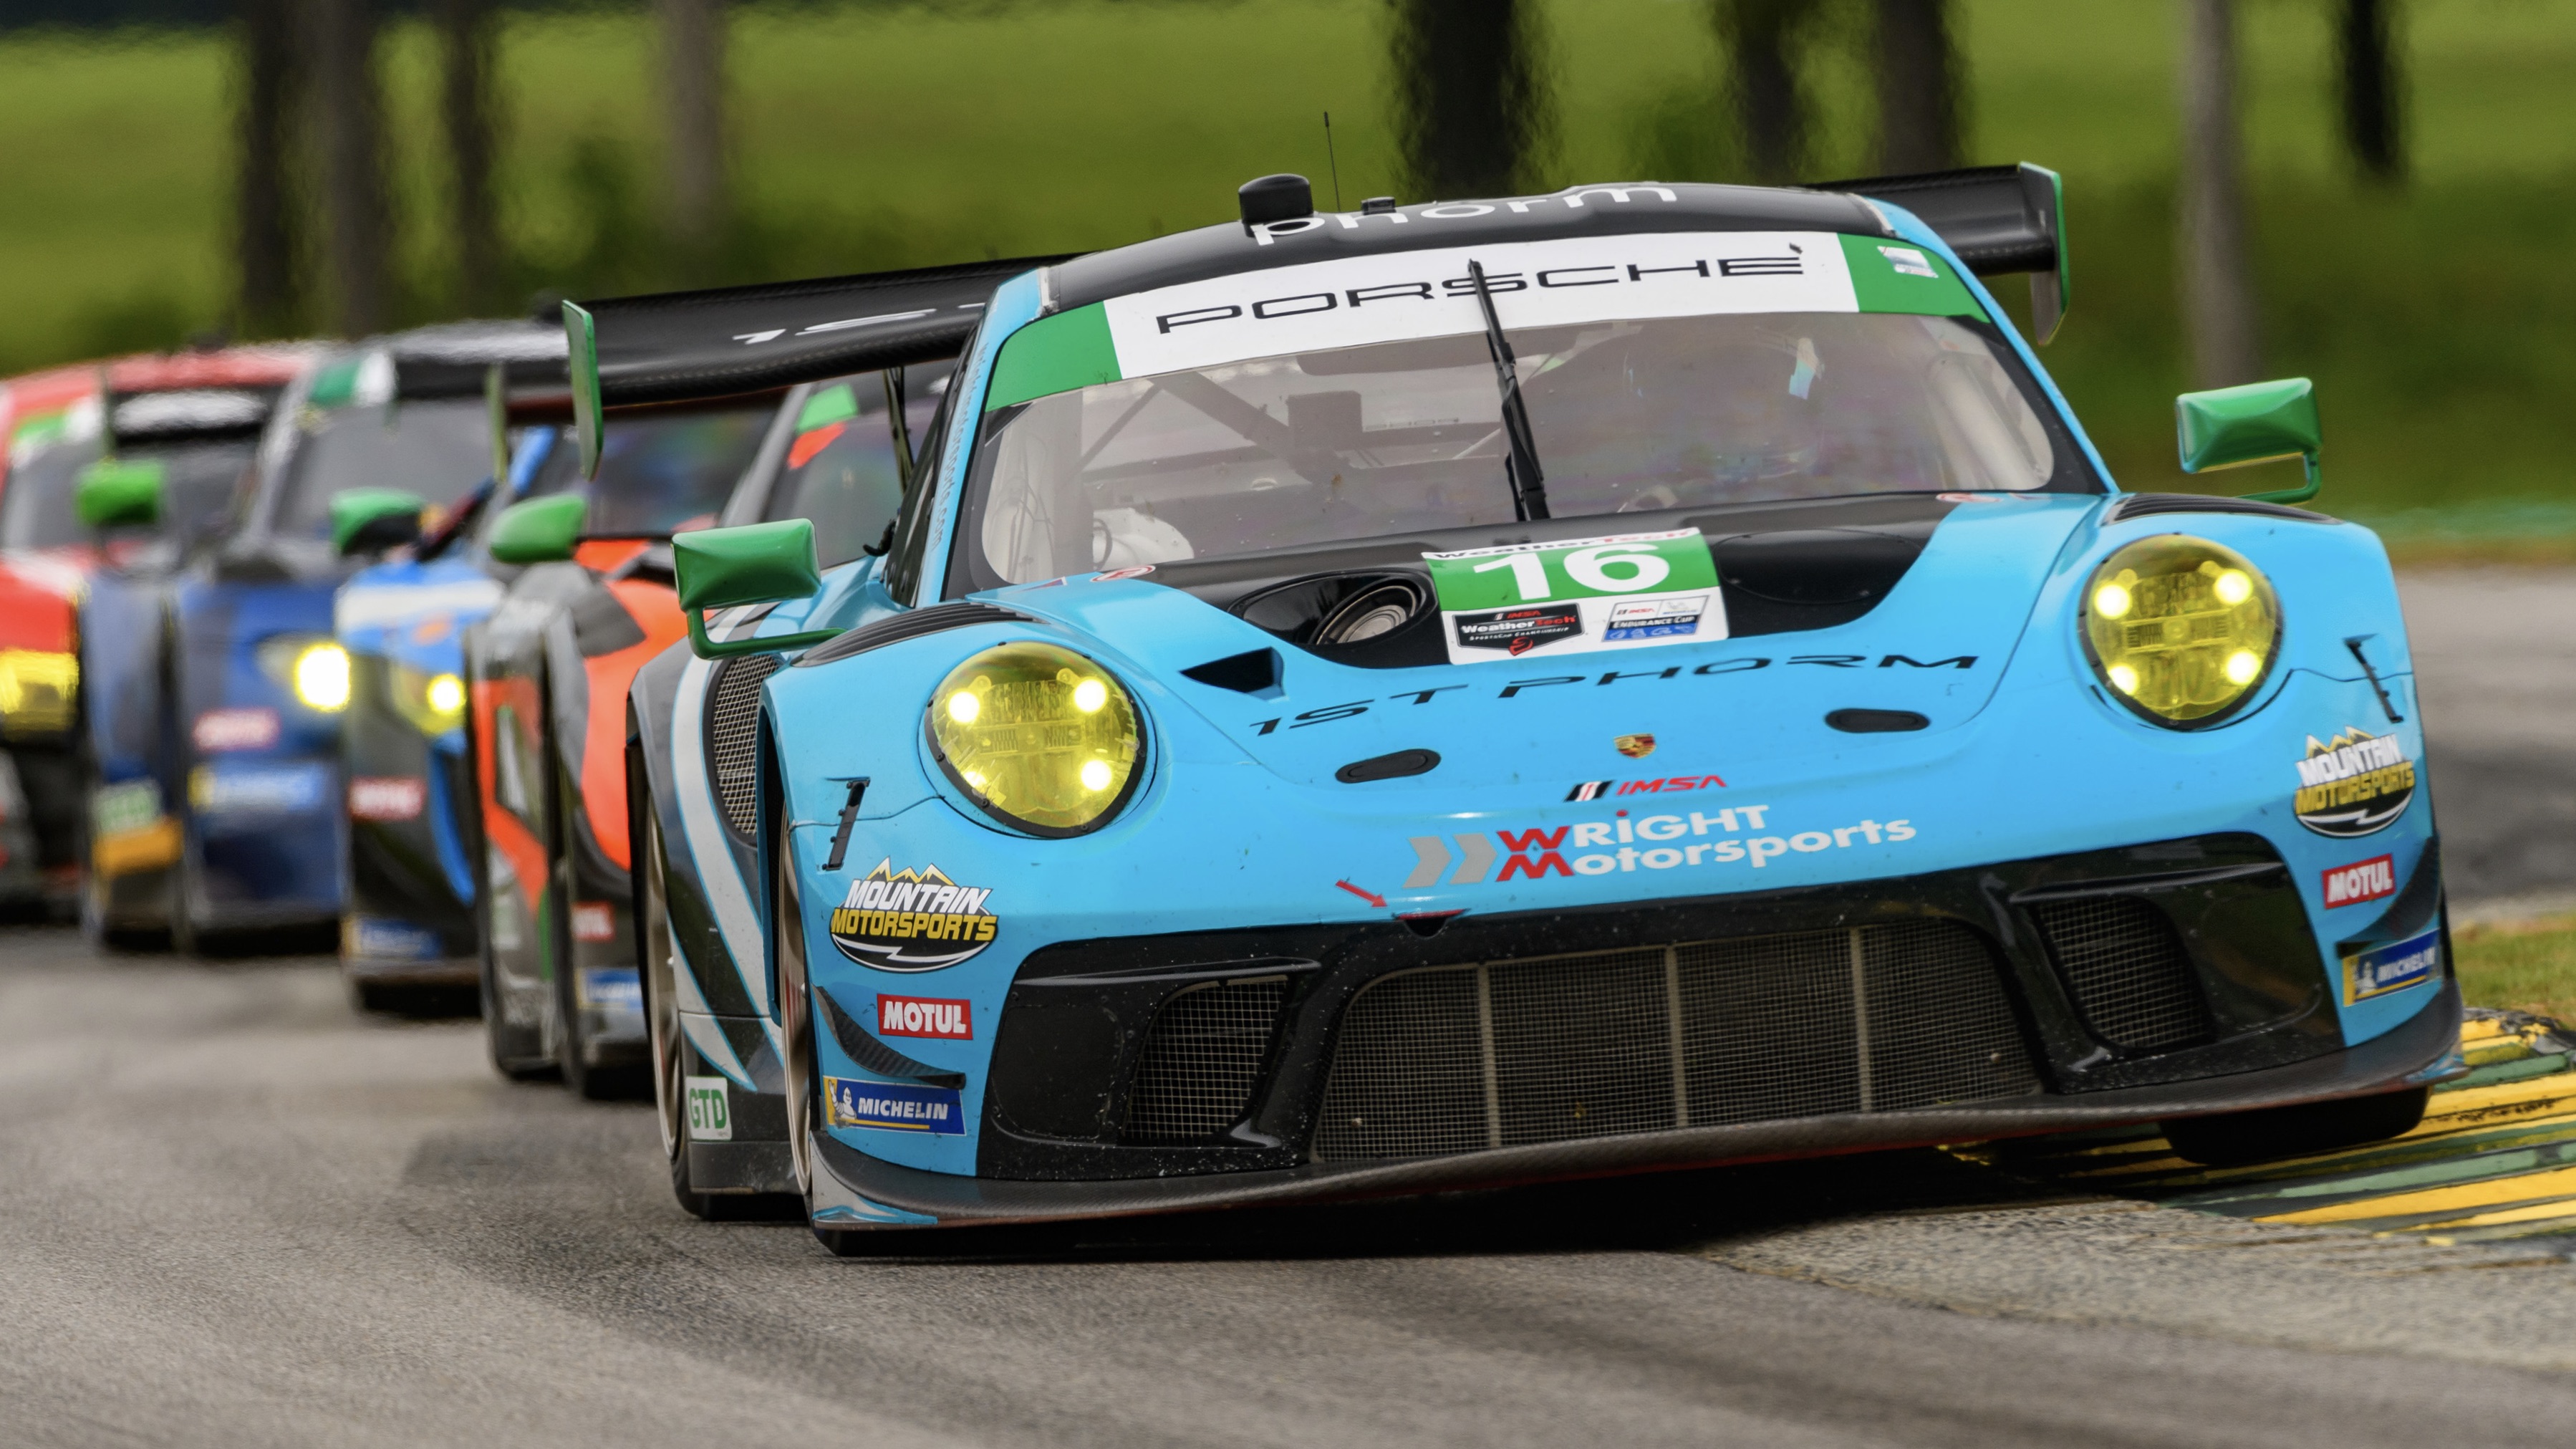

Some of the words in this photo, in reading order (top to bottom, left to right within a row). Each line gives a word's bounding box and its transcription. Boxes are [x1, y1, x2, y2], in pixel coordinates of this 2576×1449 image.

[1155, 256, 1804, 334] PORSCHE
[1472, 543, 1671, 601] 16
[1461, 615, 1576, 634] WeatherTech
[1506, 610, 1542, 620] IMSA
[1250, 683, 1468, 736] 1ST
[1497, 655, 1979, 698] PHORM
[2295, 733, 2404, 788] MOUNTAIN
[1616, 775, 1727, 796] IMSA
[2295, 760, 2416, 816] MOTORSPORTS
[1495, 819, 1917, 882] Motorsports
[844, 879, 992, 915] MOUNTAIN
[2327, 860, 2393, 903] MOTUL
[831, 908, 998, 941] MOTORSPORTS
[2377, 946, 2436, 983] MICHELIN
[882, 1001, 967, 1034] MOTUL
[688, 1087, 727, 1130] GTD
[858, 1097, 949, 1120] MICHELIN
